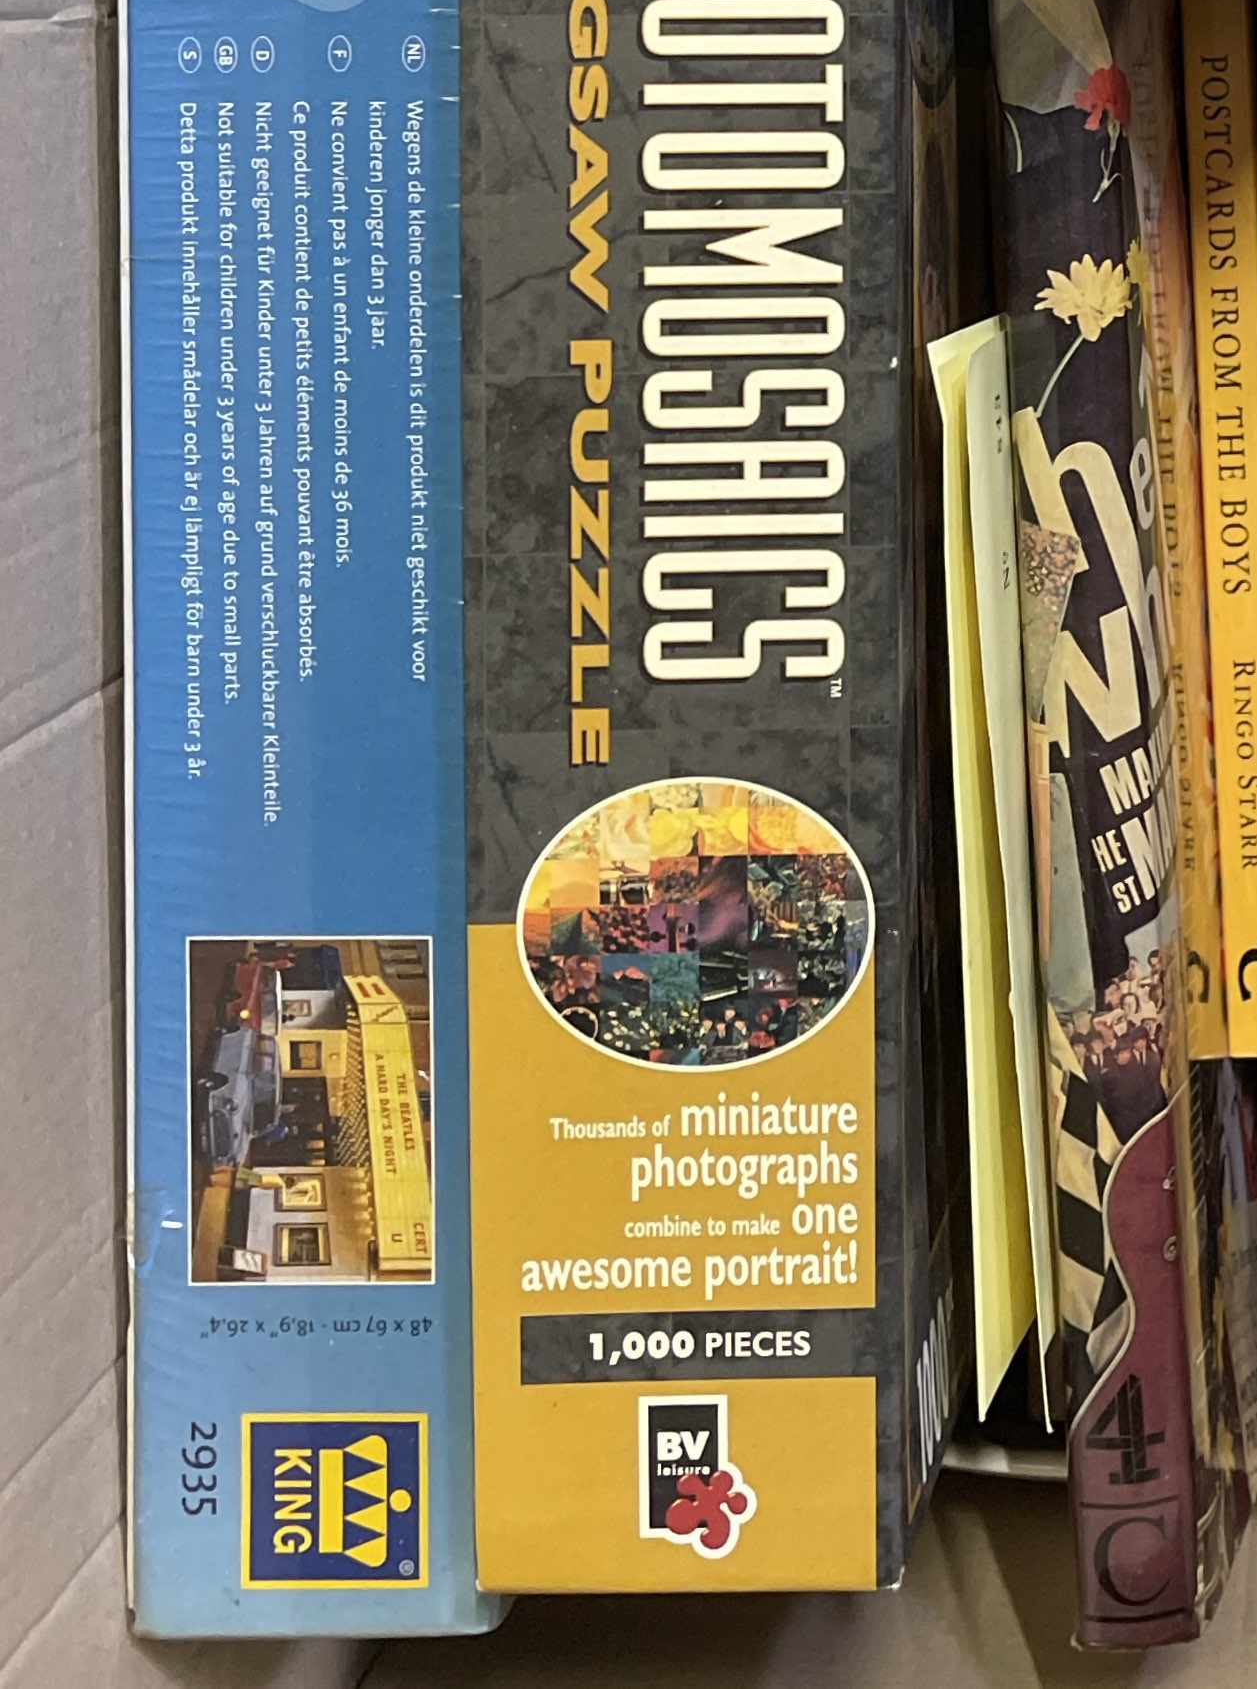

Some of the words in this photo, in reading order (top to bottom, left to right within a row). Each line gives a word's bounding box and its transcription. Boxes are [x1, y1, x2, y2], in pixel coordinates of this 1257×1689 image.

[179, 102, 197, 155] Detta
[217, 102, 235, 137] Not
[255, 101, 274, 152] Nicht
[330, 101, 348, 127] Ne
[369, 101, 388, 183] kinderen
[401, 99, 424, 175] Wegens
[217, 142, 237, 218] suitable
[331, 132, 349, 213] convient
[1200, 55, 1238, 271] POSTCARDS
[176, 161, 200, 235] produkt
[250, 157, 274, 241] geeignet
[407, 180, 427, 204] de
[219, 222, 238, 250] for
[327, 218, 347, 251] pas
[364, 186, 388, 249] jonger
[407, 209, 427, 265] kleine
[257, 245, 276, 274] für
[332, 256, 352, 267] à
[370, 254, 389, 290] dan
[182, 240, 202, 336] innehåller
[219, 254, 238, 330] children
[333, 273, 347, 297] un
[366, 295, 385, 305] 3
[257, 279, 276, 341] Kinder
[365, 308, 389, 350] jaar.
[408, 270, 428, 377] onderdelen
[333, 302, 352, 365] enfant
[1210, 286, 1243, 390] FROM
[182, 340, 202, 428] smådelar
[220, 336, 239, 392] under
[258, 346, 275, 398] unter
[334, 369, 352, 393] de
[216, 396, 235, 407] 3
[254, 402, 273, 412] 3
[409, 383, 427, 398] is
[215, 410, 236, 461] years
[334, 399, 352, 456] moins
[409, 402, 428, 429] dit
[183, 432, 202, 466] och
[258, 416, 277, 479] Jahren
[1217, 407, 1246, 481] THE
[184, 471, 202, 491] är
[222, 465, 240, 487] of
[334, 461, 353, 485] de
[405, 434, 429, 509] produkt
[179, 495, 202, 512] ej
[217, 490, 236, 525] age
[259, 484, 279, 517] auf
[331, 490, 353, 513] 36
[222, 529, 241, 565] due
[254, 520, 279, 577] grund
[335, 518, 353, 568] mois.
[411, 514, 429, 551] niet
[569, 339, 613, 767] PUZZLE
[1220, 499, 1251, 595] BOYS
[180, 517, 204, 596] lämpligt
[223, 570, 240, 591] to
[405, 556, 430, 635] geschikt
[186, 601, 204, 629] för
[223, 595, 242, 646] small
[186, 634, 204, 677] barn
[261, 581, 280, 729] verschluckbarer
[412, 639, 426, 682] voor
[219, 651, 241, 705] parts.
[187, 682, 205, 738] under
[1233, 660, 1256, 760] RINGO
[183, 742, 201, 752] 3
[187, 757, 207, 780] år.
[262, 734, 282, 827] Kleinteile.
[376, 1065, 388, 1093] HARD
[396, 1074, 407, 1094] THE
[380, 1098, 392, 1130] DAY'S
[400, 1103, 414, 1150] BEATLES
[548, 1115, 647, 1140] Thousands
[651, 1114, 672, 1138] of
[681, 1091, 858, 1137] miniature
[383, 1136, 396, 1174] NIGHT
[631, 1139, 858, 1202] photographs
[412, 1222, 428, 1255] CERT
[624, 1214, 702, 1238] combine
[706, 1217, 727, 1237] to
[731, 1213, 781, 1236] make
[791, 1202, 858, 1235] one
[521, 1256, 692, 1292] awesome
[704, 1239, 858, 1301] portrait!
[333, 1319, 361, 1333] cm
[365, 1315, 388, 1337] 67
[410, 1316, 433, 1337] 48
[589, 1330, 695, 1366] 1,000
[705, 1330, 811, 1358] PIECES
[657, 1431, 709, 1460] BV
[181, 1421, 218, 1516] 2935
[658, 1464, 710, 1476] leisure
[272, 1448, 312, 1554] KING
